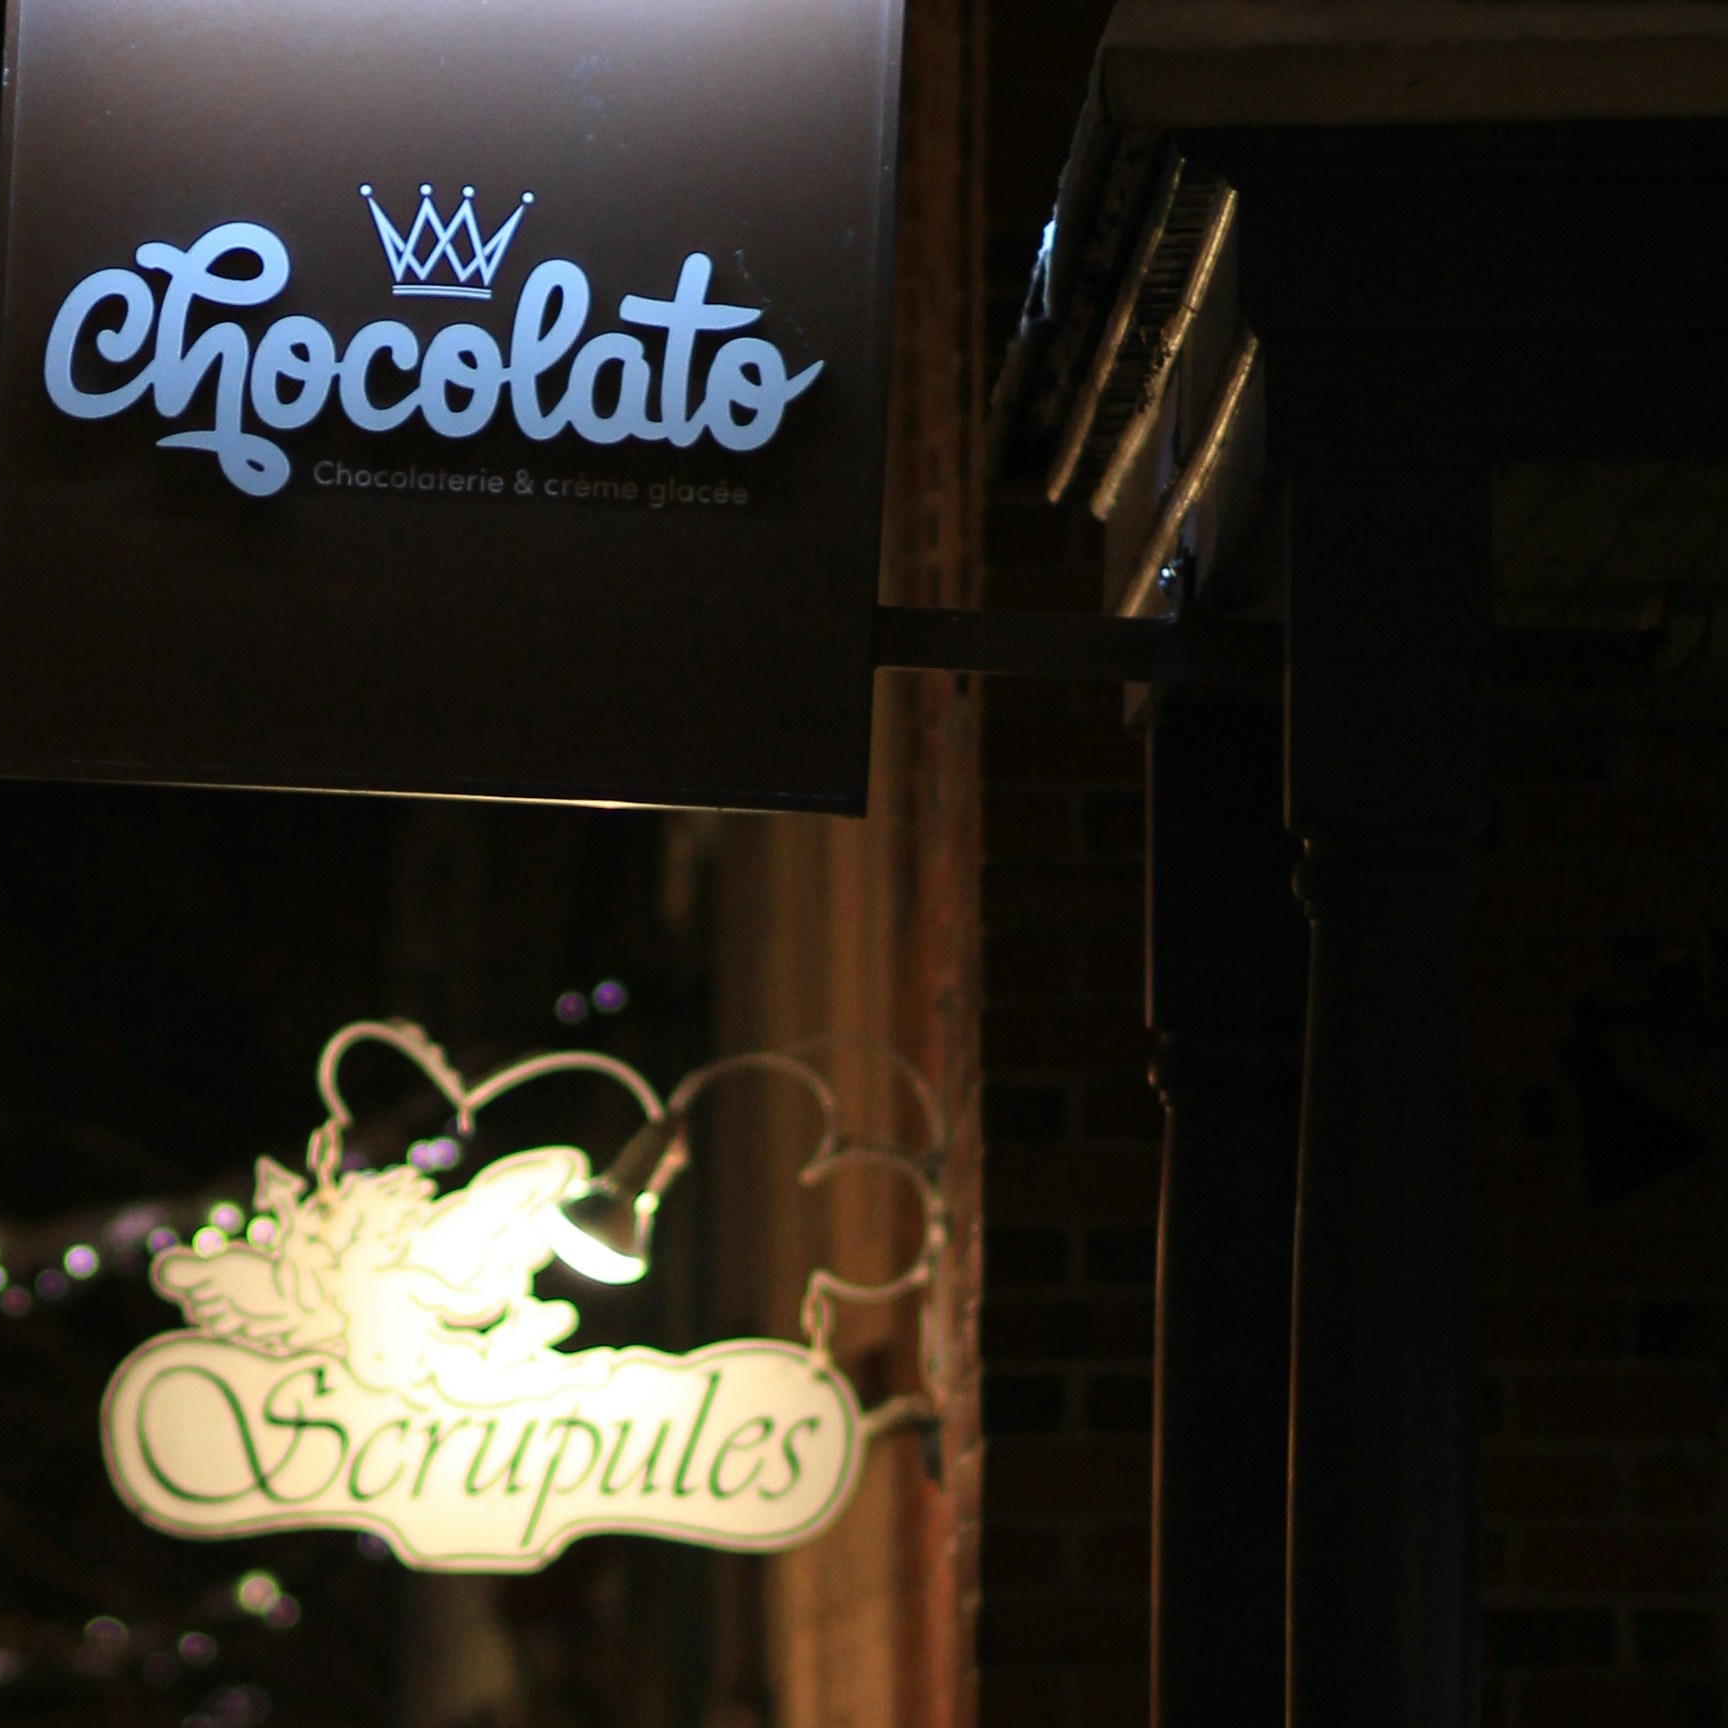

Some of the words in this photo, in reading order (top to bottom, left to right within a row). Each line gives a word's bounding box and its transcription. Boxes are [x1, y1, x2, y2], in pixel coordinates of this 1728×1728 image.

[43, 221, 824, 498] Chocolato
[312, 459, 505, 495] Chocolaterie
[512, 468, 535, 497] &
[543, 474, 639, 501] crème
[647, 475, 750, 510] glacée
[135, 1364, 821, 1551] Scrupules
